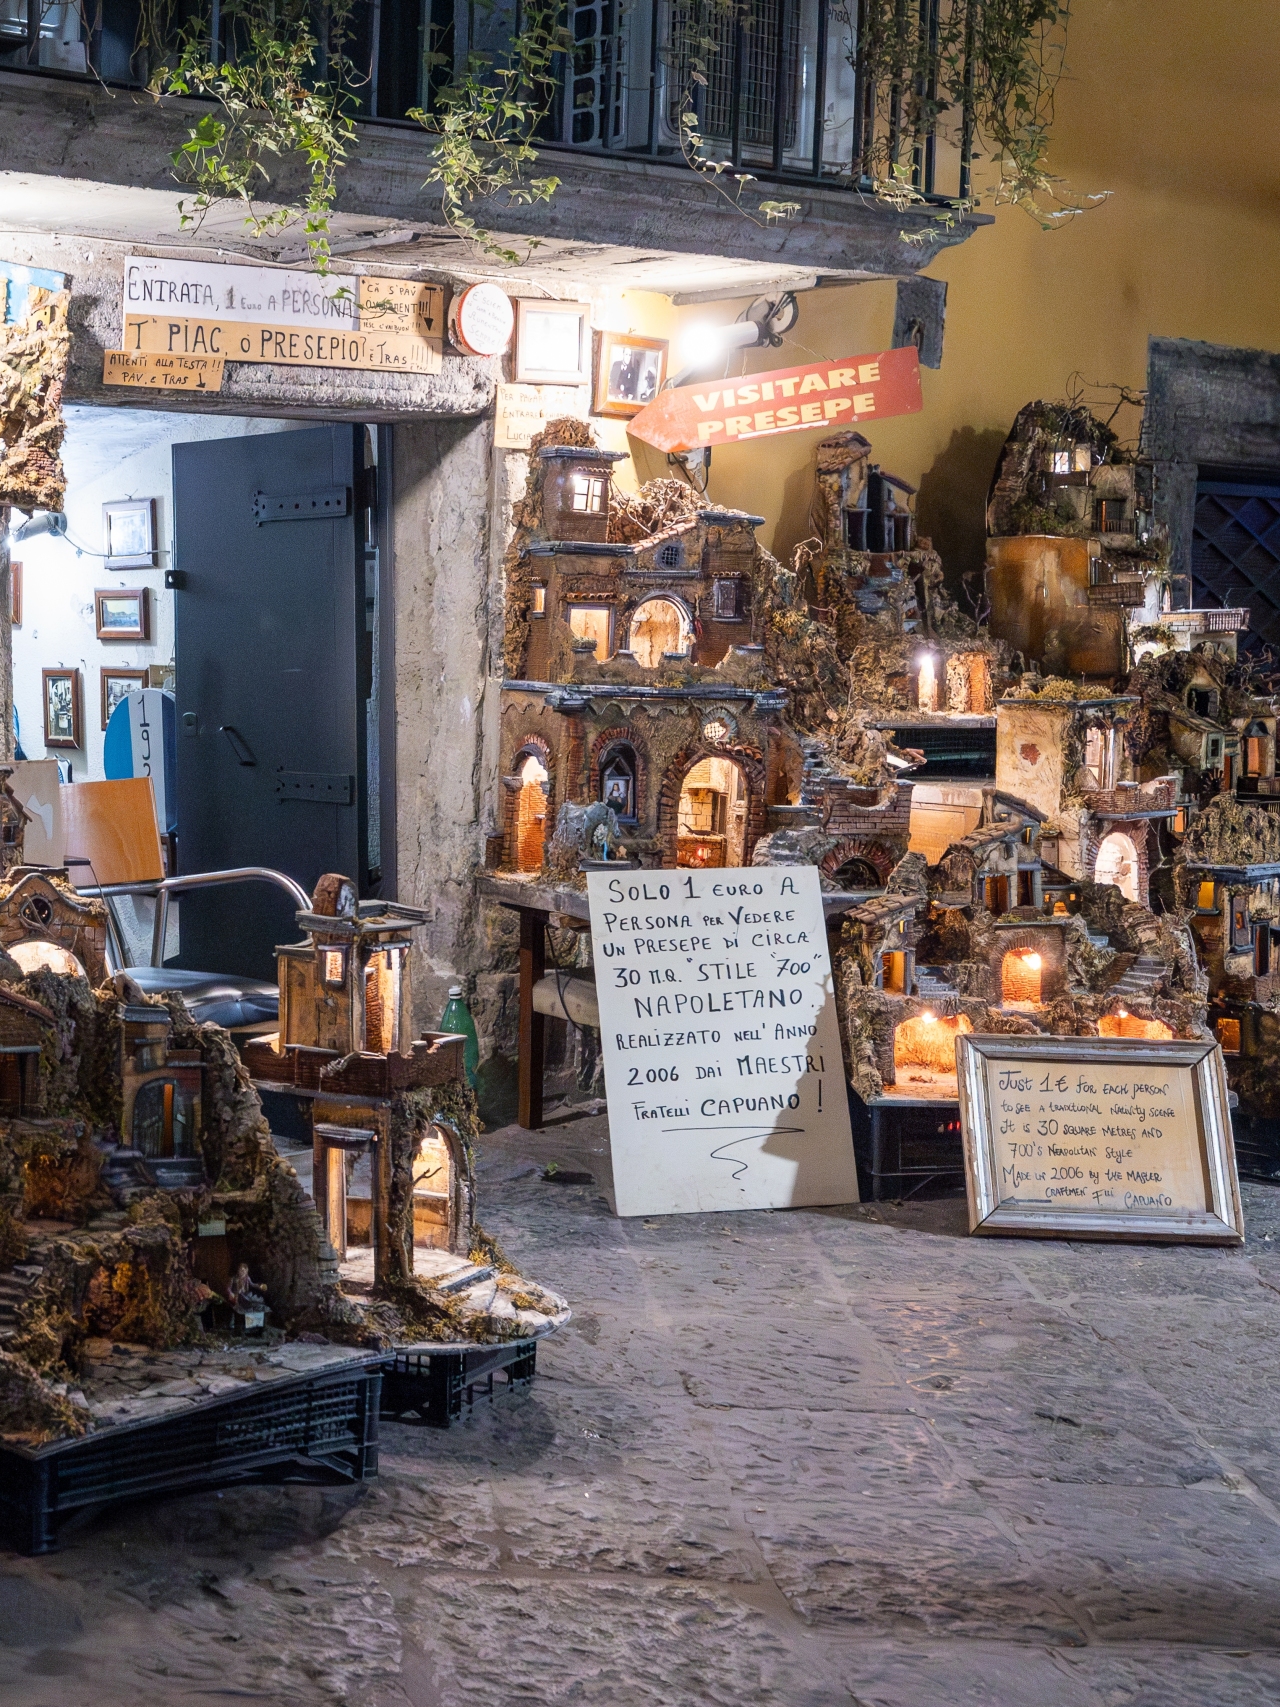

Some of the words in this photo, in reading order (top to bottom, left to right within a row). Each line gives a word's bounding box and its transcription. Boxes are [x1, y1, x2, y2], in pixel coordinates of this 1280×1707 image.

[267, 295, 276, 311] A
[282, 288, 354, 319] PERSONA
[155, 358, 174, 368] ALLA
[176, 357, 208, 370] TESTA
[162, 373, 189, 385] TRAS
[692, 362, 881, 412] VISITARE
[697, 393, 876, 441] PRESEPE
[608, 878, 670, 903] SOLO
[683, 875, 701, 899] 1
[712, 883, 764, 897] EURO
[780, 875, 800, 896] A
[602, 912, 693, 933] PERSONA
[703, 914, 725, 927] PER
[728, 905, 796, 925] VEDERE
[602, 942, 626, 958] UN
[634, 936, 712, 956] PRESEPE
[612, 967, 641, 989] 30
[774, 1023, 818, 1040] ANNO
[627, 1065, 680, 1086] 2006
[700, 1093, 801, 1117] CAPUANO
[1037, 1118, 1059, 1136] 30
[1063, 1124, 1097, 1136] SQUARE
[1141, 1127, 1163, 1139] AND
[1050, 1166, 1084, 1180] 2006
